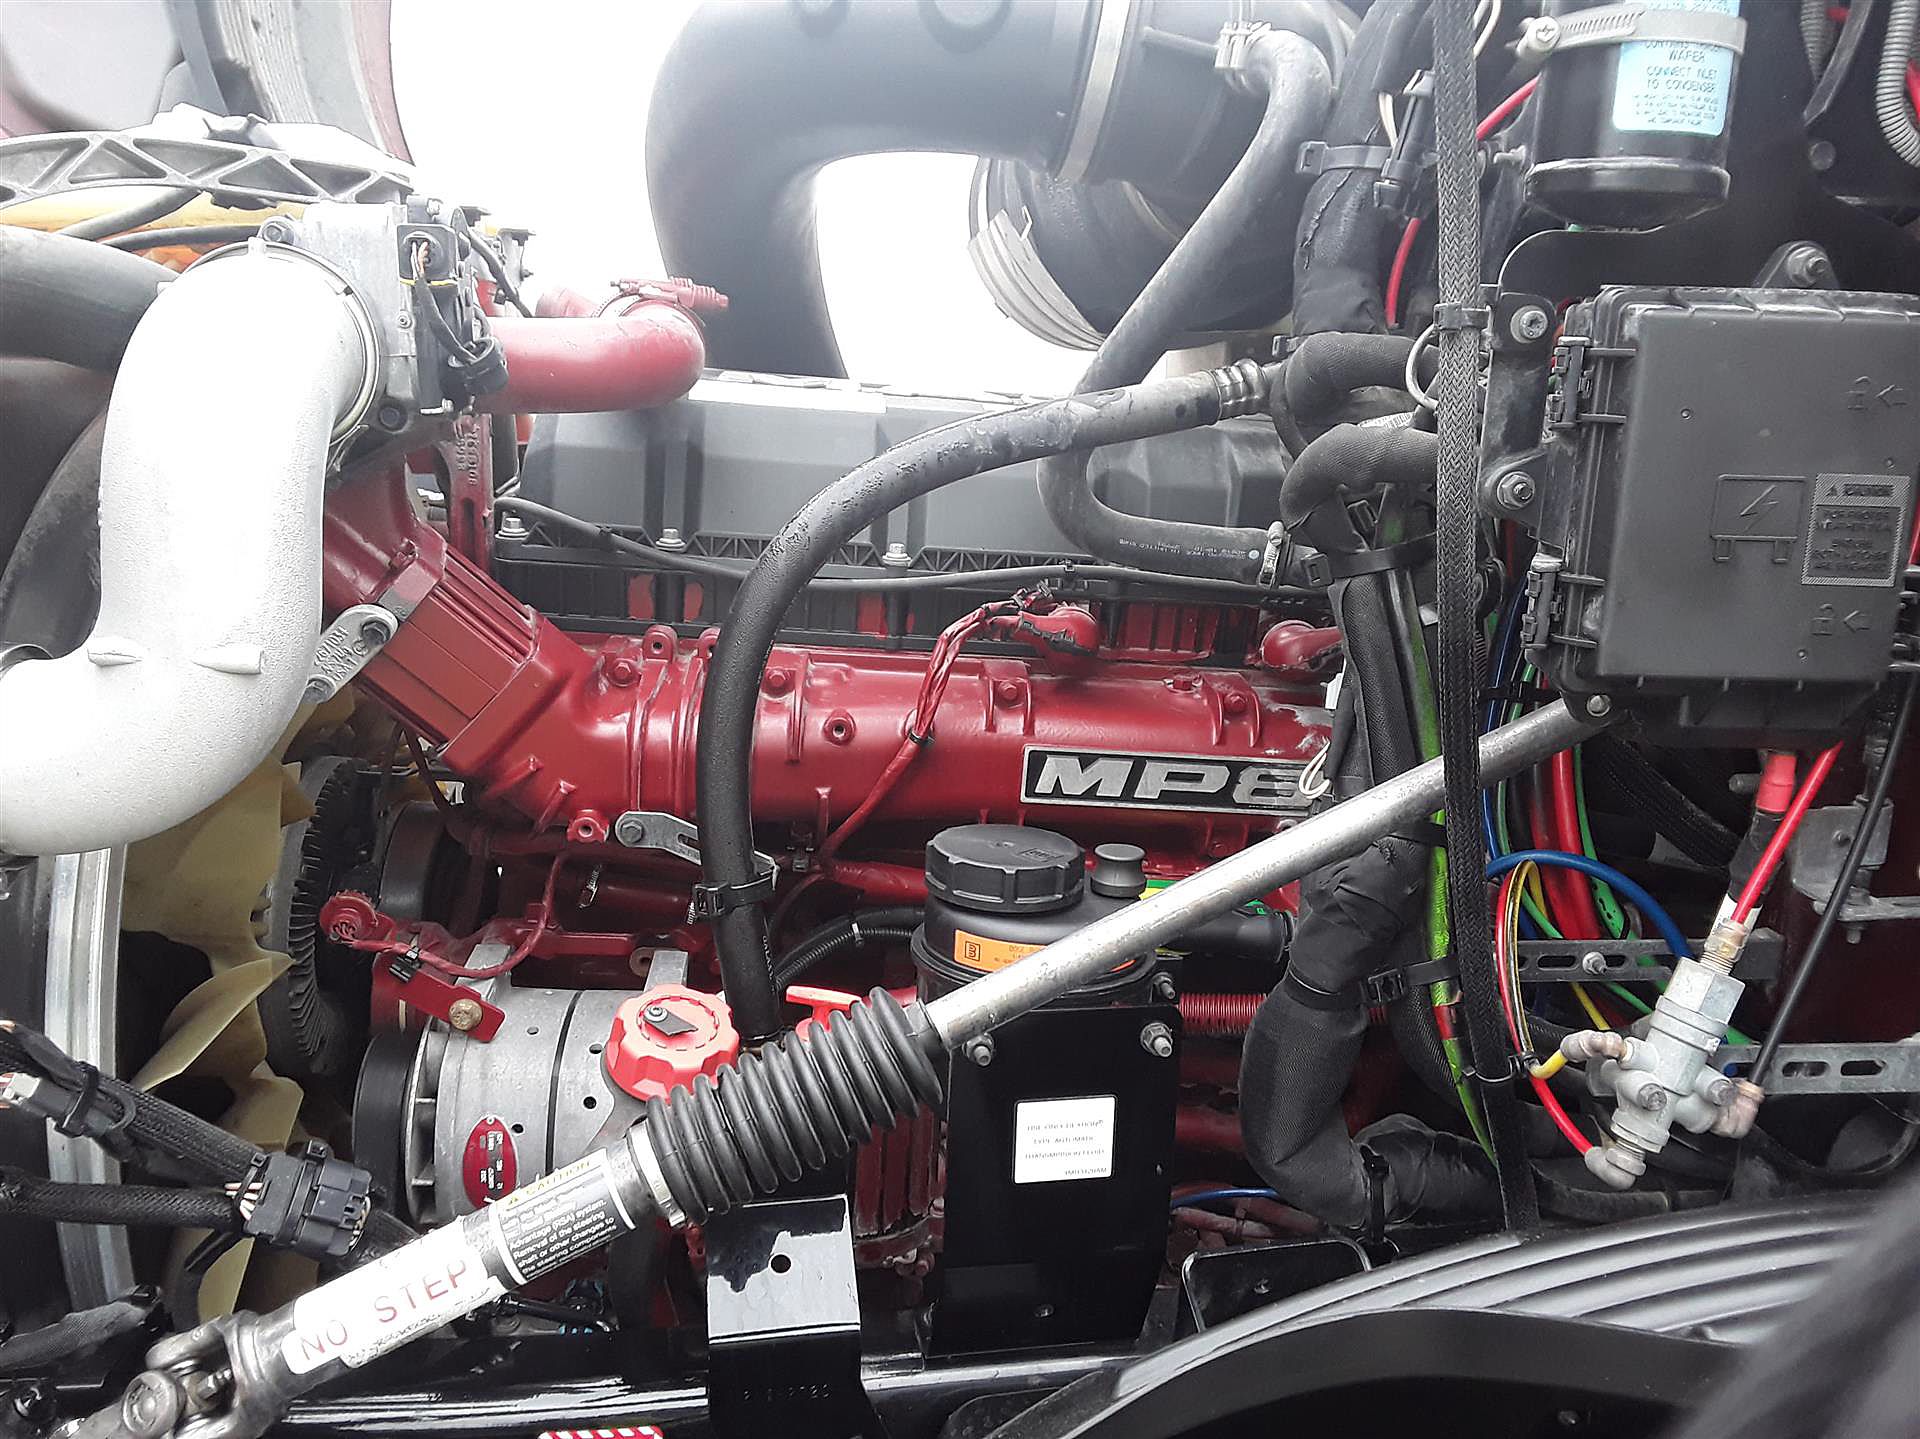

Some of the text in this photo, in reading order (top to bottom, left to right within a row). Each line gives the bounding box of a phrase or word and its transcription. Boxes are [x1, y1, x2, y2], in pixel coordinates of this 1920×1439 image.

[1034, 754, 1325, 809] MP8
[510, 1226, 552, 1250] Advantage
[552, 1213, 575, 1231] (RSA)
[513, 1211, 606, 1260] Removal of the steering
[518, 1217, 615, 1268] shaft or other changes to
[522, 1264, 535, 1274] the
[537, 1250, 569, 1267] steering
[569, 1225, 617, 1251] components
[300, 1319, 348, 1361] NO
[373, 1259, 467, 1324] STEP
